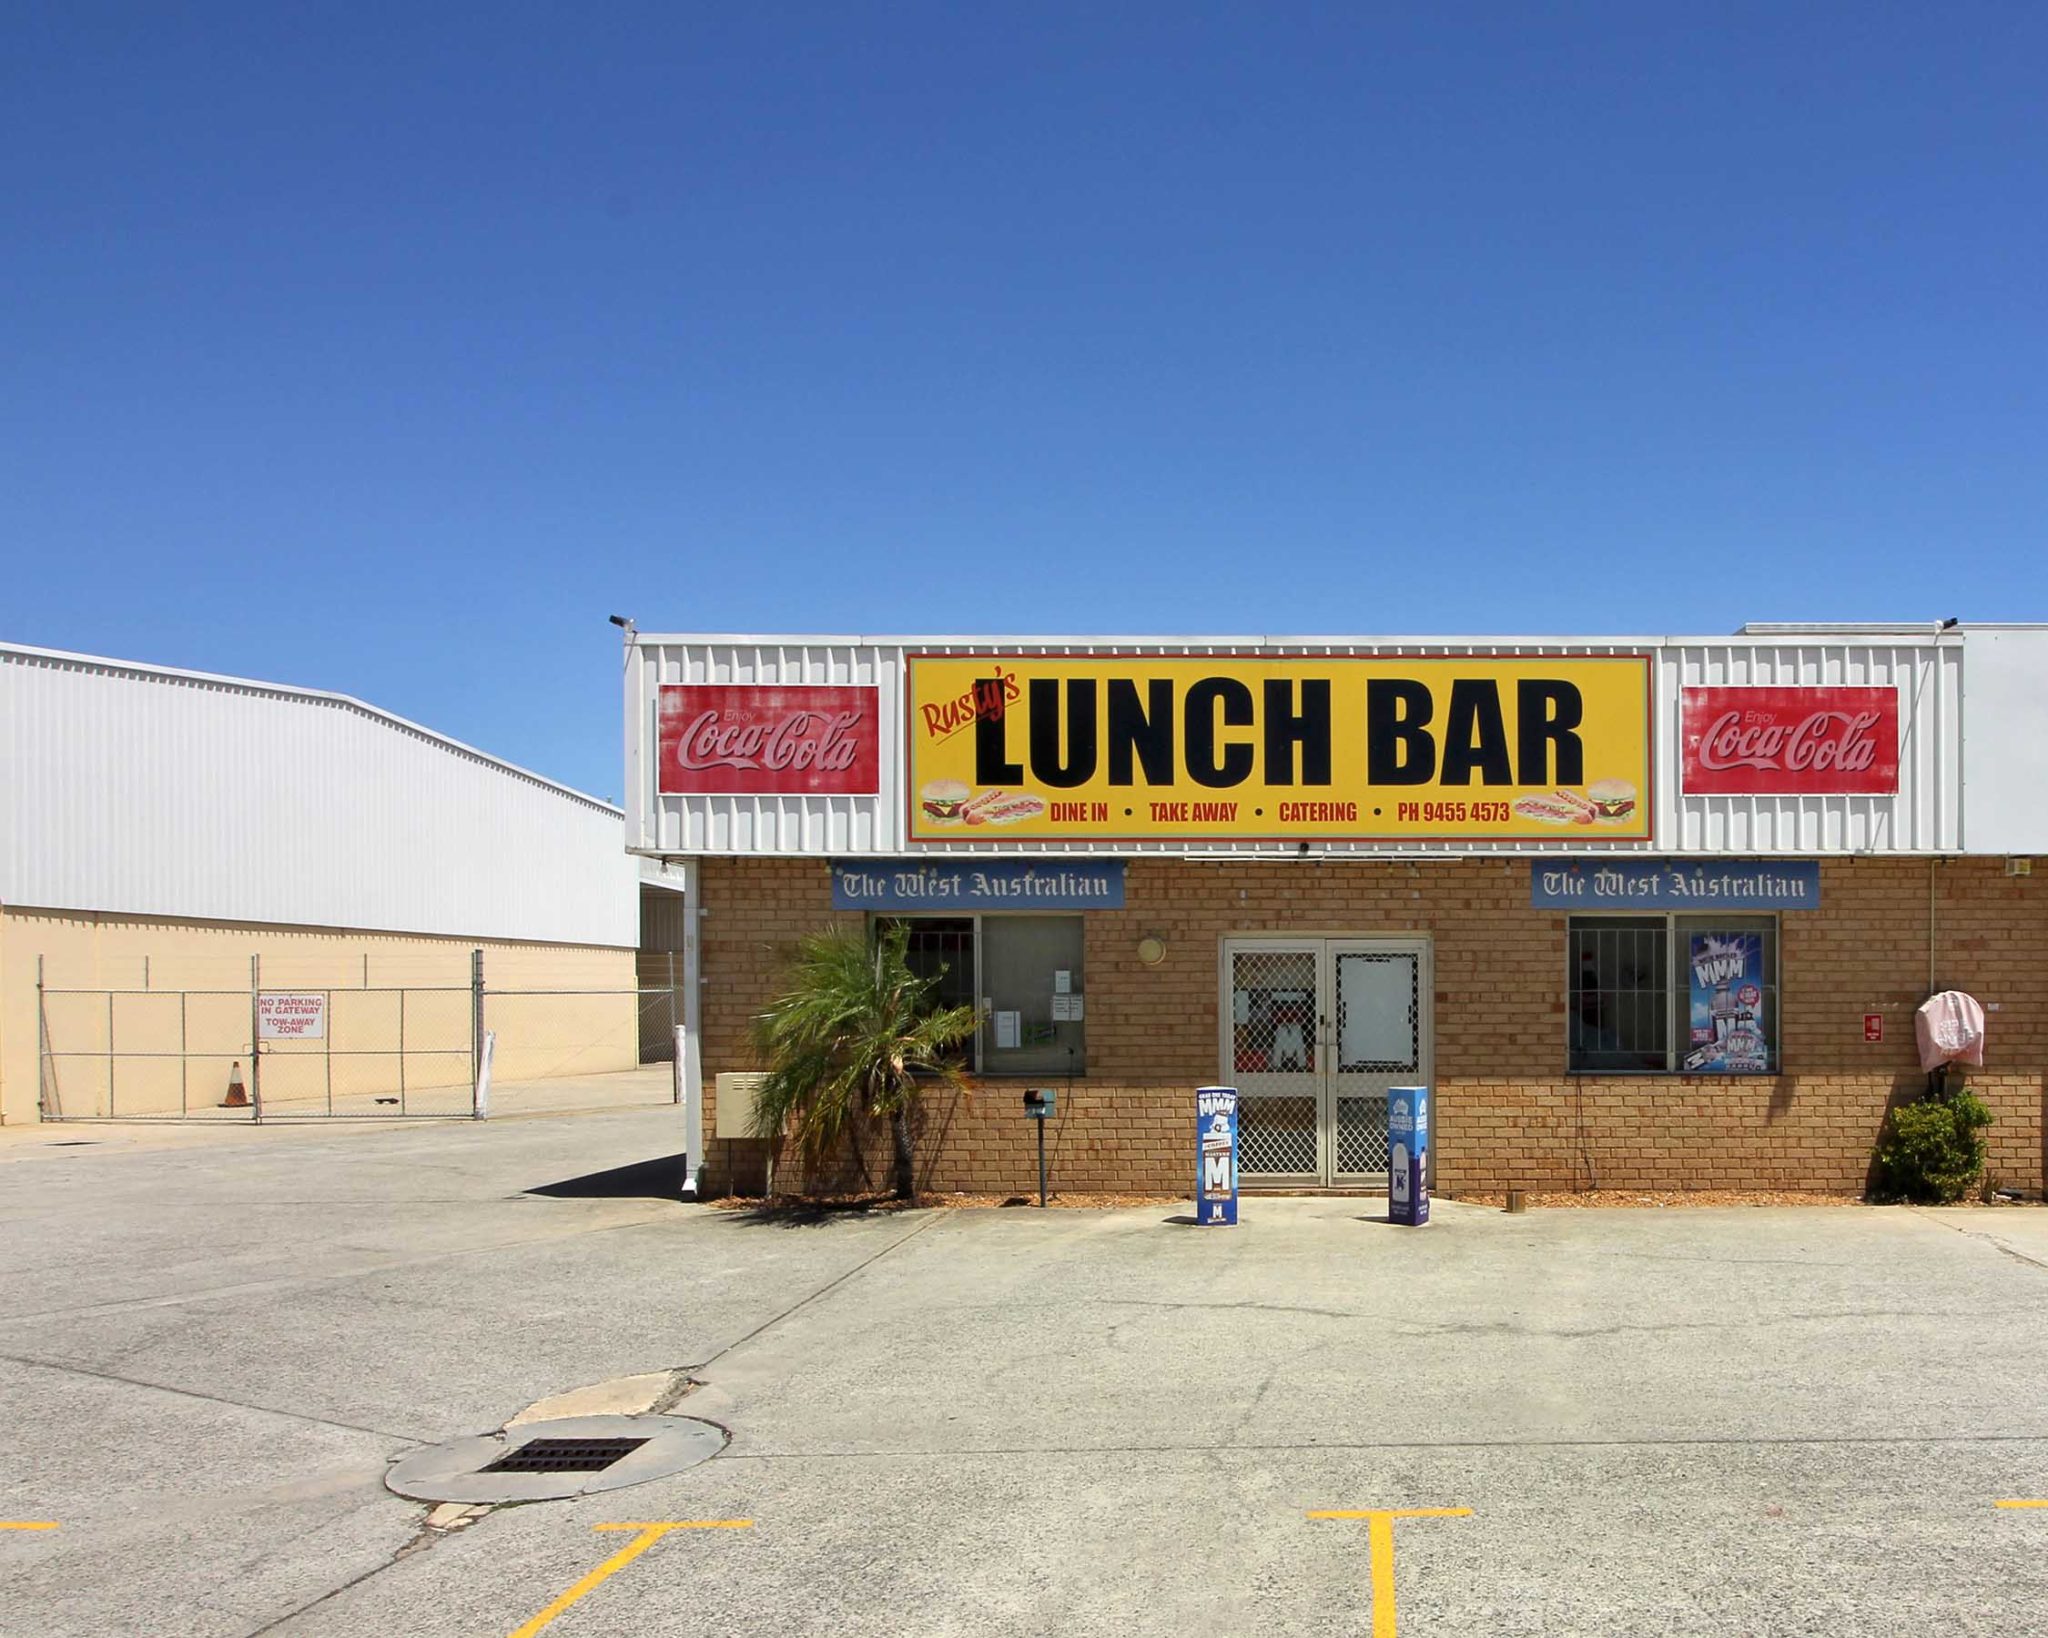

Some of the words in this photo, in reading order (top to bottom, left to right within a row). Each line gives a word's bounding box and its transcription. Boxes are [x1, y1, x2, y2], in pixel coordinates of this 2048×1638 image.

[920, 666, 1021, 737] Rusty's
[723, 709, 757, 723] Enjoy
[1744, 710, 1777, 724] Enjoy
[677, 710, 863, 772] Coca-Cola
[975, 677, 1331, 789] LUNCH
[1367, 679, 1583, 786] BAR
[1700, 711, 1882, 772] Coca-Cola
[1050, 802, 1087, 822] DINE
[1091, 802, 1108, 822] IN
[1149, 802, 1188, 822] TAKE
[1192, 802, 1238, 822] AWAY
[1279, 802, 1357, 822] CATERING
[1398, 802, 1420, 822] PH
[1423, 802, 1466, 822] 9455
[1470, 802, 1511, 822] 4573
[843, 873, 886, 898] The
[895, 872, 962, 898] West
[969, 872, 1109, 897] Australian
[1543, 871, 1586, 897] The
[1594, 871, 1661, 897] West
[1668, 872, 1806, 897] Australian
[1695, 959, 1744, 989] MMM
[260, 998, 274, 1007] NO
[278, 998, 322, 1007] PARKING
[261, 1006, 272, 1015] IN
[275, 1006, 320, 1015] GATEWAY
[266, 1017, 315, 1026] TOW-AWAY
[277, 1025, 304, 1034] ZONE
[1199, 1098, 1236, 1117] MMM
[1205, 1157, 1229, 1191] M
